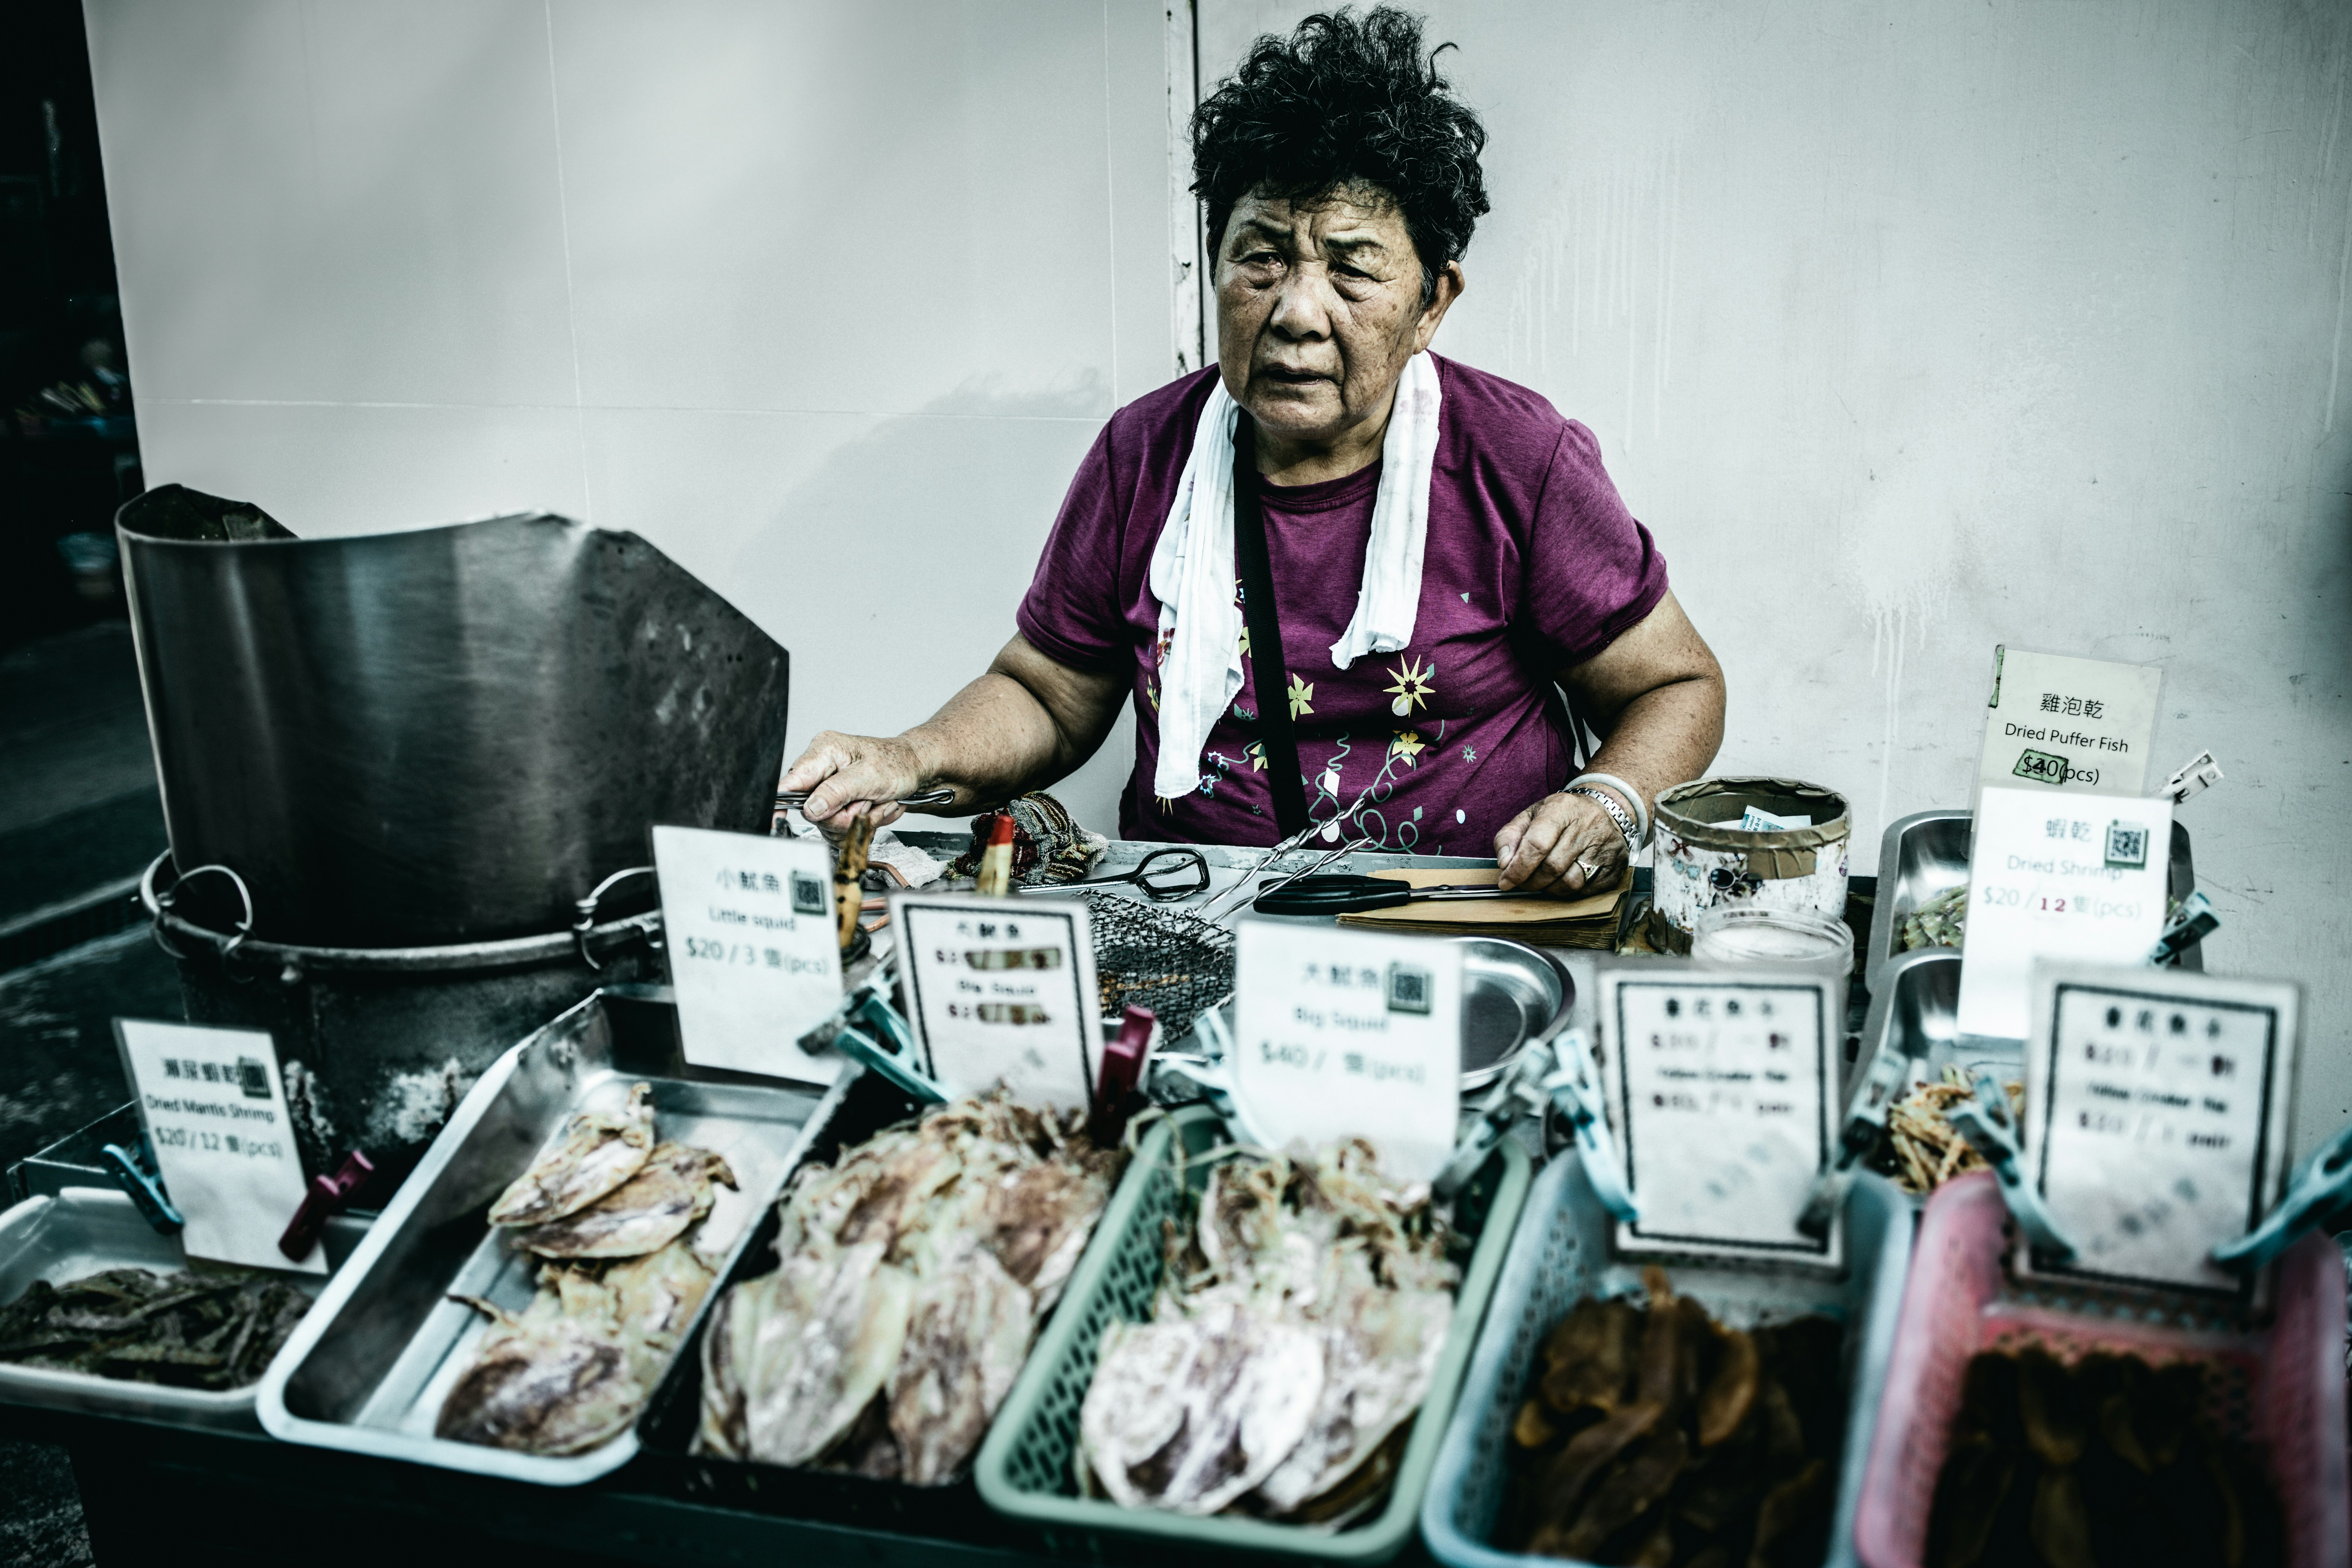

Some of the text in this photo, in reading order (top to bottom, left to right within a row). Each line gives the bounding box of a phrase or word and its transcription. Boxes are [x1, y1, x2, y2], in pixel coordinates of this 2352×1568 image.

[2040, 694, 2104, 719] 雞泡乾
[2005, 723, 2128, 753] Dried Puffer Fish
[2045, 818, 2092, 842] 蝦乾
[2007, 854, 2123, 880] Dried Shrimp
[1984, 886, 2020, 906] $20
[709, 906, 796, 931] Little squid
[686, 936, 724, 960] $20
[145, 1094, 274, 1123] Dried Mantis Shrimp
